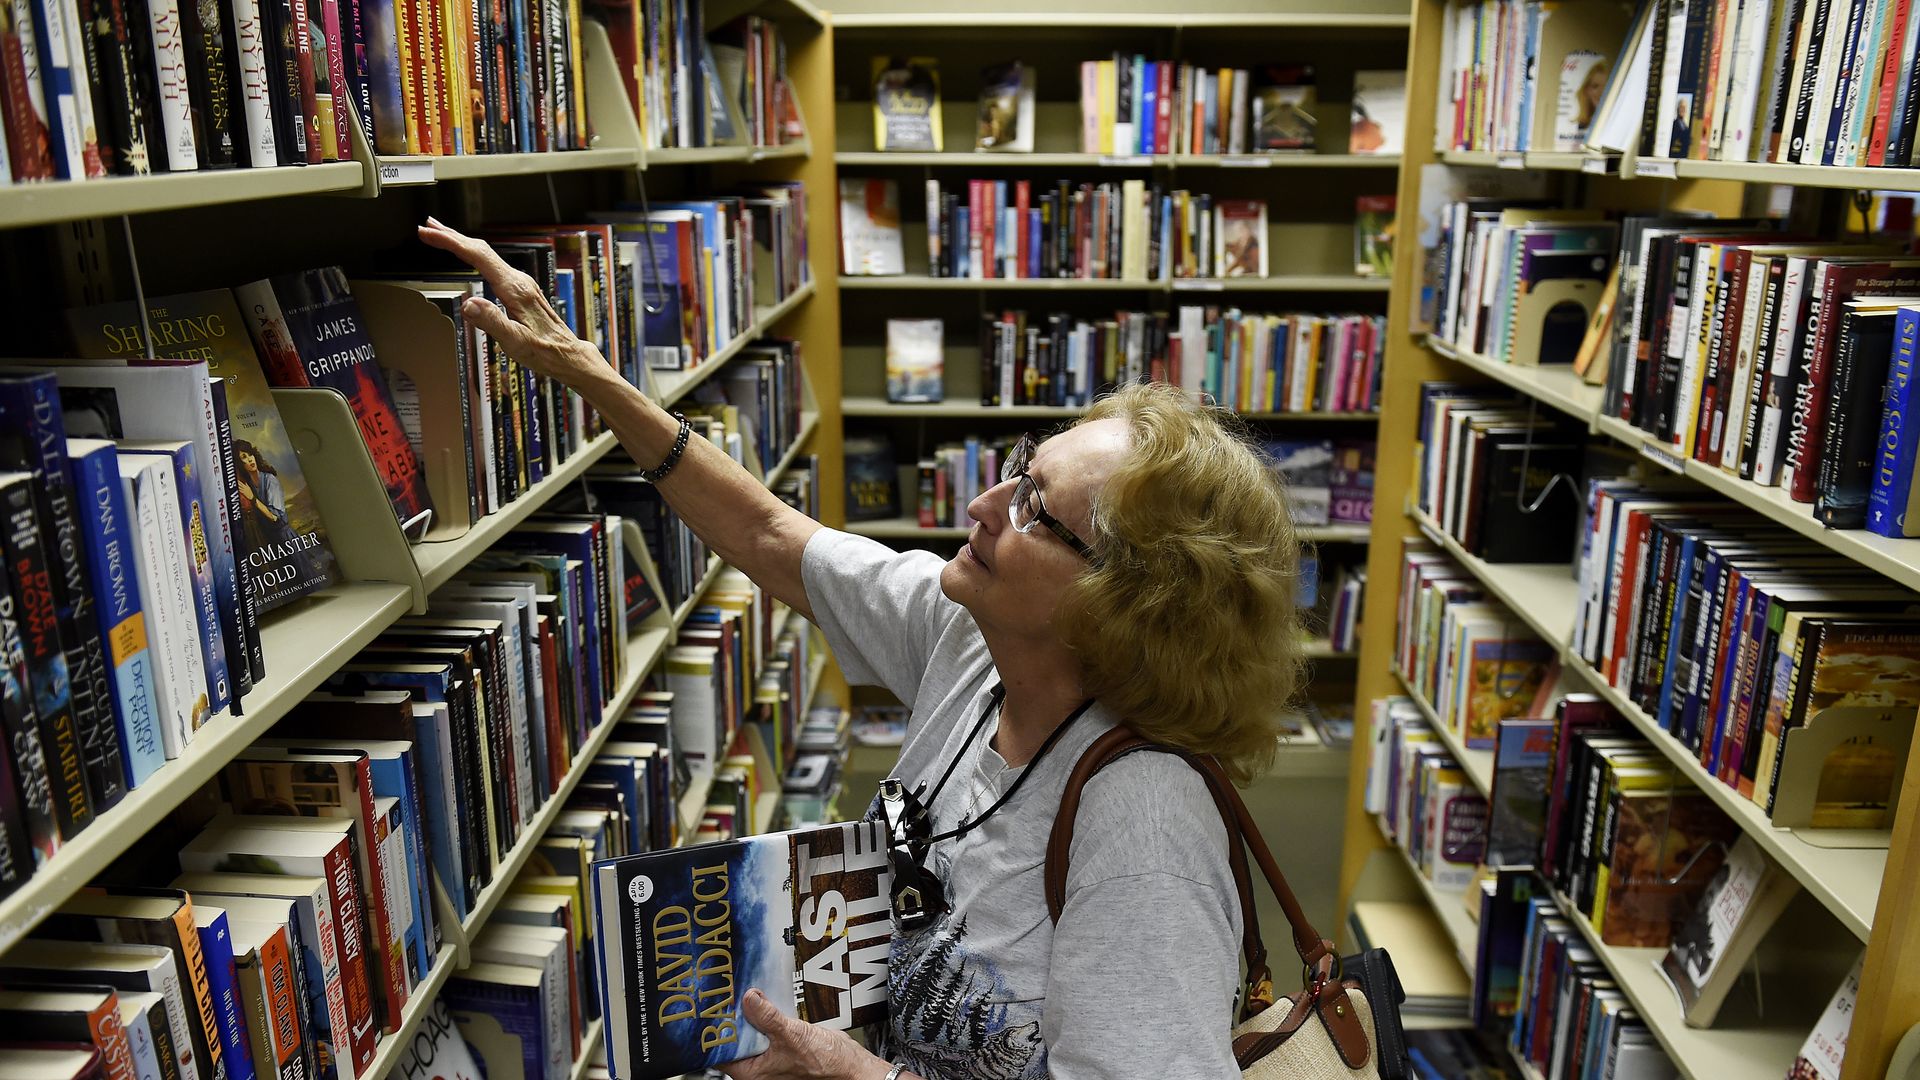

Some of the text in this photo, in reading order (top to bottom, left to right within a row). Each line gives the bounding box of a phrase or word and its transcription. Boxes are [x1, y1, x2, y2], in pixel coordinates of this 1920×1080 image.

[154, 12, 178, 100] MYTH
[239, 18, 262, 100] MYTH
[471, 0, 483, 82] NIGHT WATCH
[1887, 22, 1904, 74] Strayed
[204, 33, 223, 130] DECEPTION
[214, 47, 229, 118] KING'S
[285, 60, 297, 98] BERRY
[329, 34, 346, 142] SHAYLA BLACK
[439, 44, 448, 111] TWENTY-TWO
[1796, 44, 1817, 120] HILLENBRAND
[1834, 78, 1846, 109] BOND
[360, 83, 374, 146] LOVE KILLS
[150, 308, 169, 319] THE
[1823, 302, 1831, 324] STILL
[1828, 278, 1835, 287] IN
[1856, 278, 1867, 287] The
[1868, 278, 1895, 288] Strange
[103, 314, 226, 354] SHARING
[308, 343, 376, 378] GRIPPANDO
[316, 316, 356, 342] JAMES
[1708, 280, 1729, 379] ARMAGEDDON
[1814, 351, 1822, 374] NIGHT
[1822, 325, 1828, 334] OF
[1896, 318, 1915, 389] SHIP
[1744, 282, 1777, 448] DEFENDING THE FREE MARKET
[1785, 302, 1821, 468] BOBBY BROWN
[1803, 378, 1815, 420] ANN
[1823, 312, 1851, 454] Children The Days
[503, 414, 515, 482] IDEAL MAN
[531, 395, 541, 443] CLAW
[1793, 424, 1808, 472] RULE
[1880, 409, 1903, 487] GOLD
[219, 418, 241, 521] MYSTERIOUS WAYS
[33, 402, 88, 618] DALE BROWN
[204, 398, 220, 476] ABSENCE
[218, 498, 232, 554] MERCY
[229, 567, 238, 600] JOHN
[235, 608, 247, 656] BURLEY
[96, 485, 128, 617] DAN BROWN
[17, 558, 48, 656] BROWN
[34, 571, 57, 630] DALE
[205, 584, 218, 638] ROBERT
[264, 574, 328, 604] BESTSELLING AUTHOR
[598, 571, 607, 628] HIGGINS
[1701, 568, 1728, 700] LOST IN SHANGRI-LA
[1796, 636, 1806, 658] THE
[68, 646, 106, 767] INTENT
[86, 634, 120, 765] EXECUTIVE
[131, 659, 155, 756] DECEPTION
[1734, 637, 1760, 746] BROKEN TRUST
[1783, 659, 1801, 720] MAYOR
[129, 697, 147, 753] POINT
[14, 731, 39, 809] CLAW
[54, 714, 88, 825] STARFIRE
[366, 764, 389, 916] MARY HIGGINS CLARK
[334, 861, 350, 901] TOM
[842, 819, 893, 1009] MILE
[327, 919, 336, 961] Tom
[339, 901, 358, 963] CLANCY
[635, 907, 643, 949] BESTSELLING
[691, 861, 738, 1053] BALDACCI
[797, 843, 853, 1031] LAST
[354, 957, 366, 998] AGAINST
[653, 905, 697, 1028] DAVID
[792, 969, 805, 1009] THE
[163, 976, 184, 1050] CHIAVERINI
[192, 949, 206, 992] LEE
[200, 992, 221, 1053] CHILD
[223, 988, 240, 1048] INTO THE FIRE
[271, 956, 295, 1051] TOM CLANCY
[640, 1003, 647, 1011] #1
[642, 1026, 648, 1036] BY
